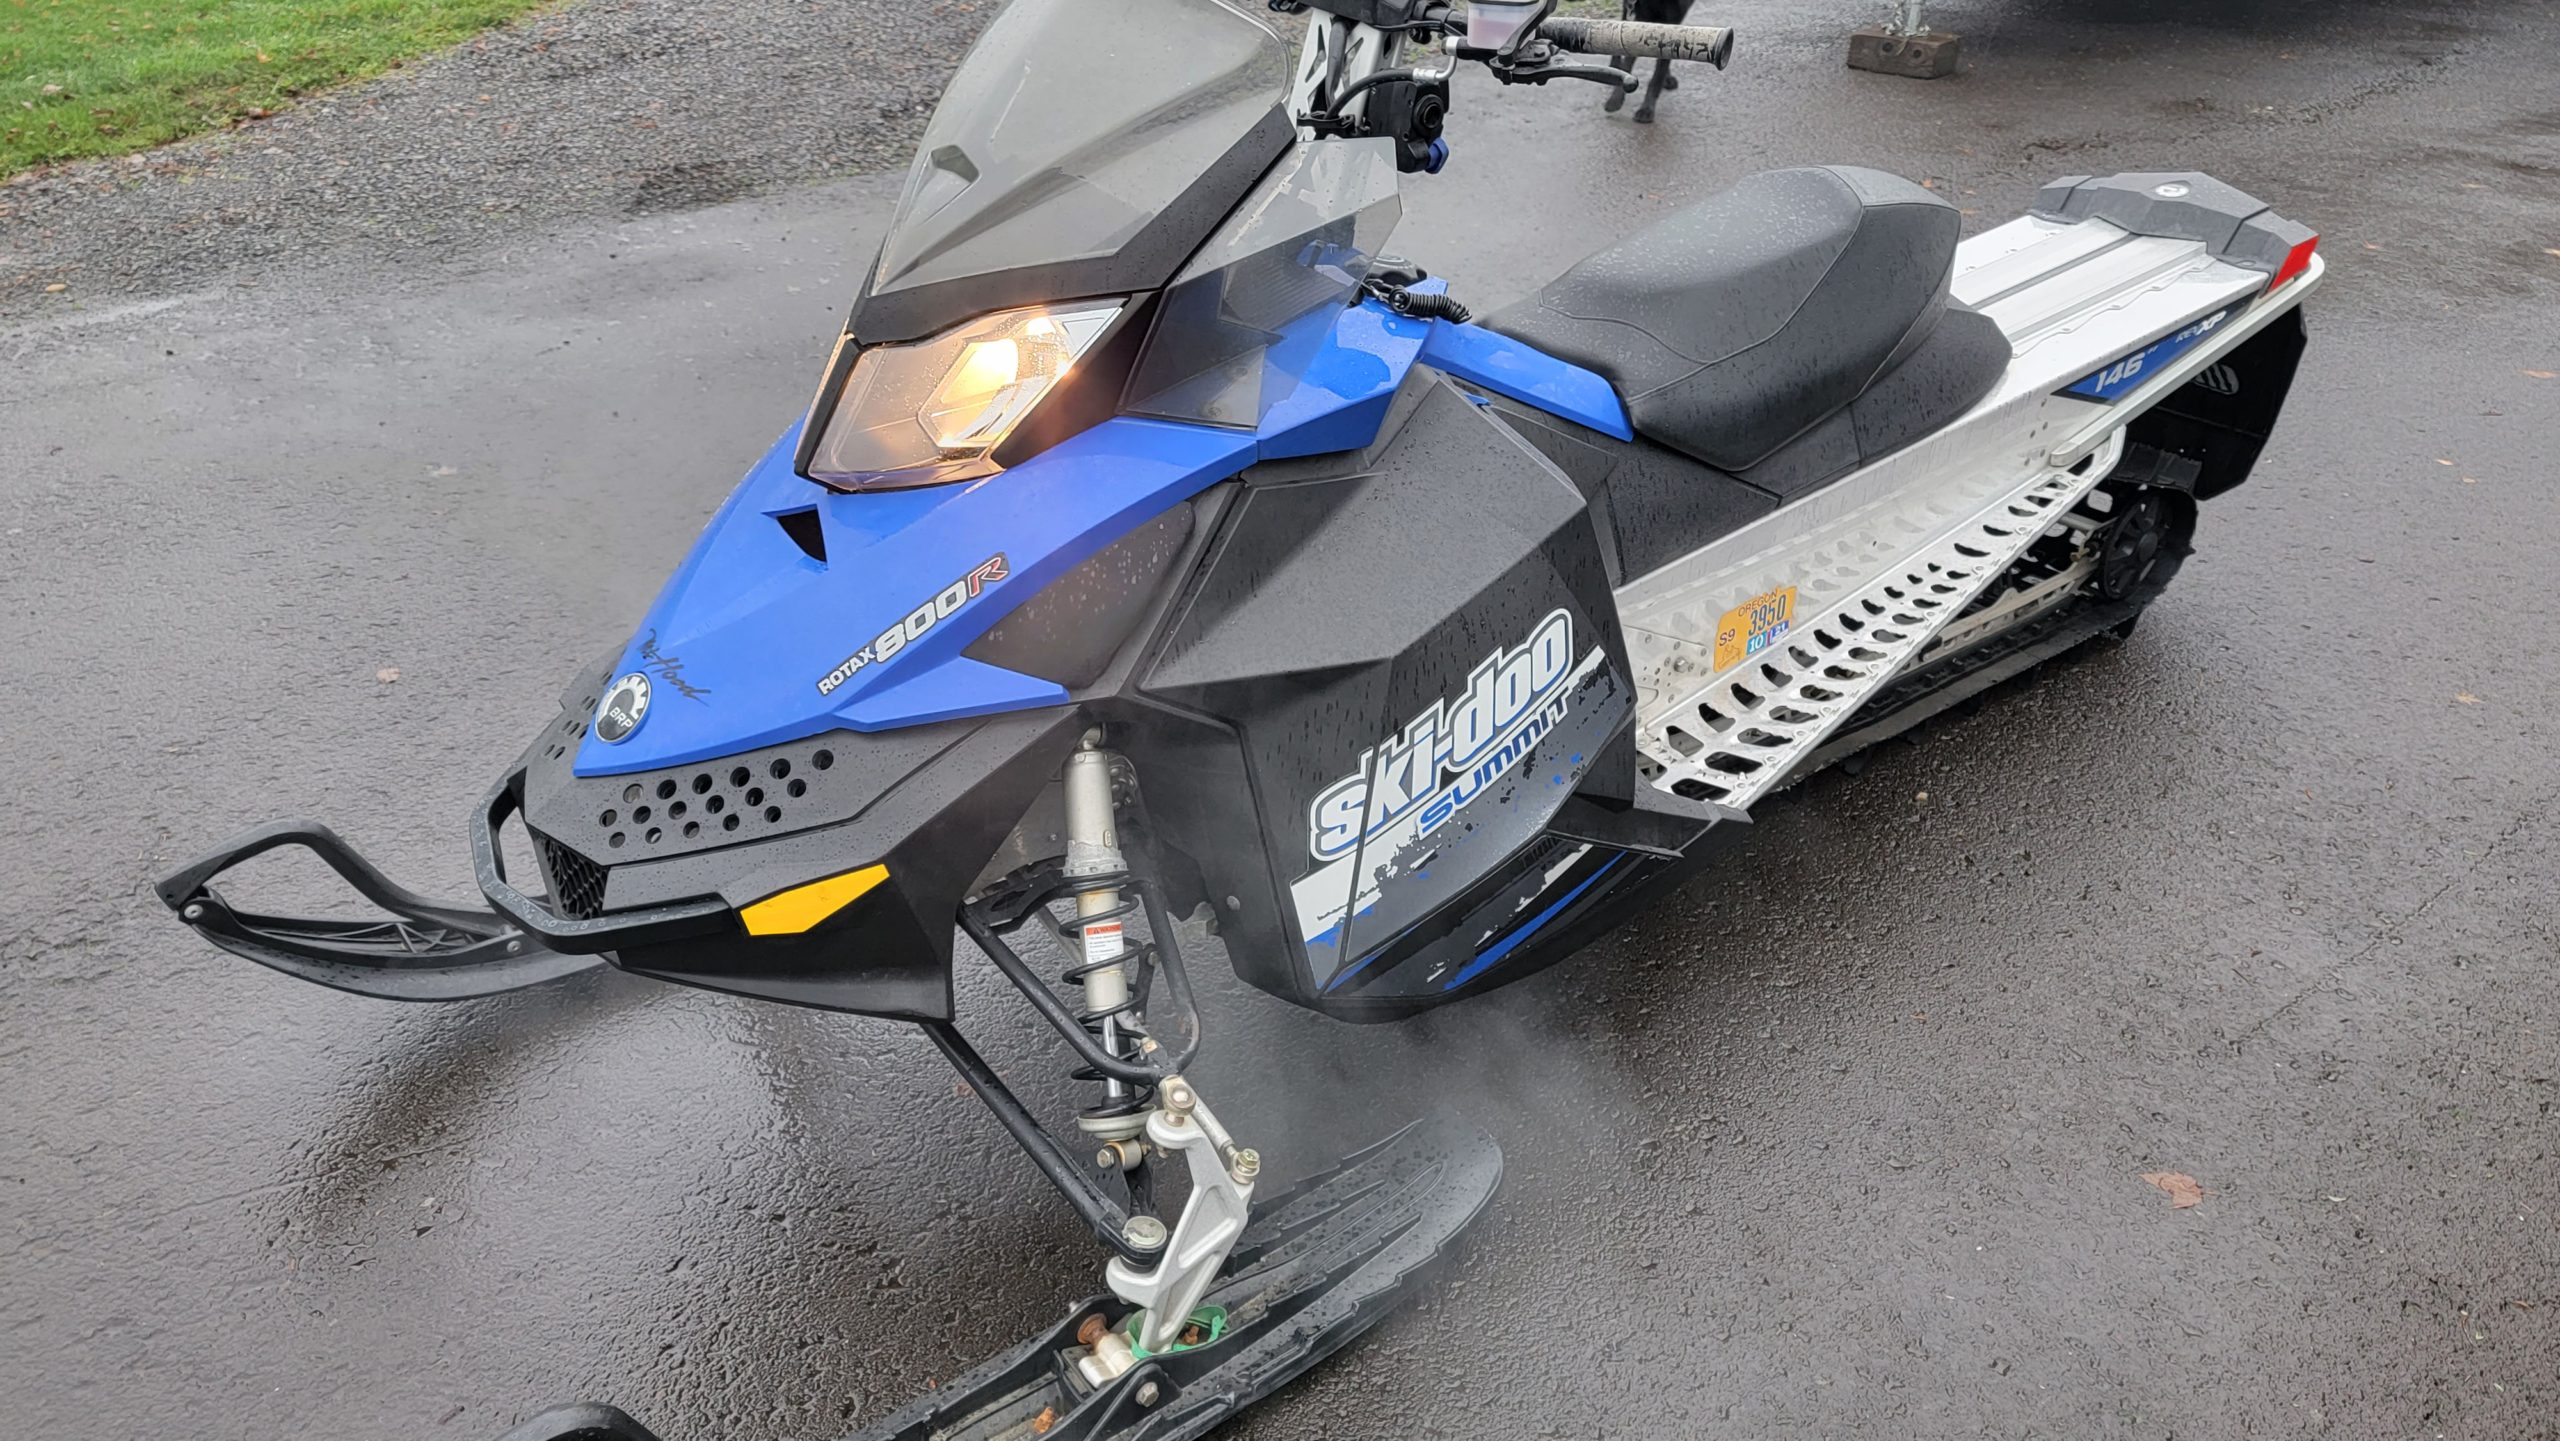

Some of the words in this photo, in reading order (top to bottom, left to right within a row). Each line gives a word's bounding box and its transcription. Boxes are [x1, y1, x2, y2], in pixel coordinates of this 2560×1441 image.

[1738, 591, 1778, 617] OREGON
[1748, 594, 1786, 636] 3950
[817, 646, 876, 695] ROTAX
[875, 556, 1008, 663] 800R
[1719, 628, 1736, 646] S9
[1749, 635, 1764, 653] 10
[609, 706, 633, 728] BRP
